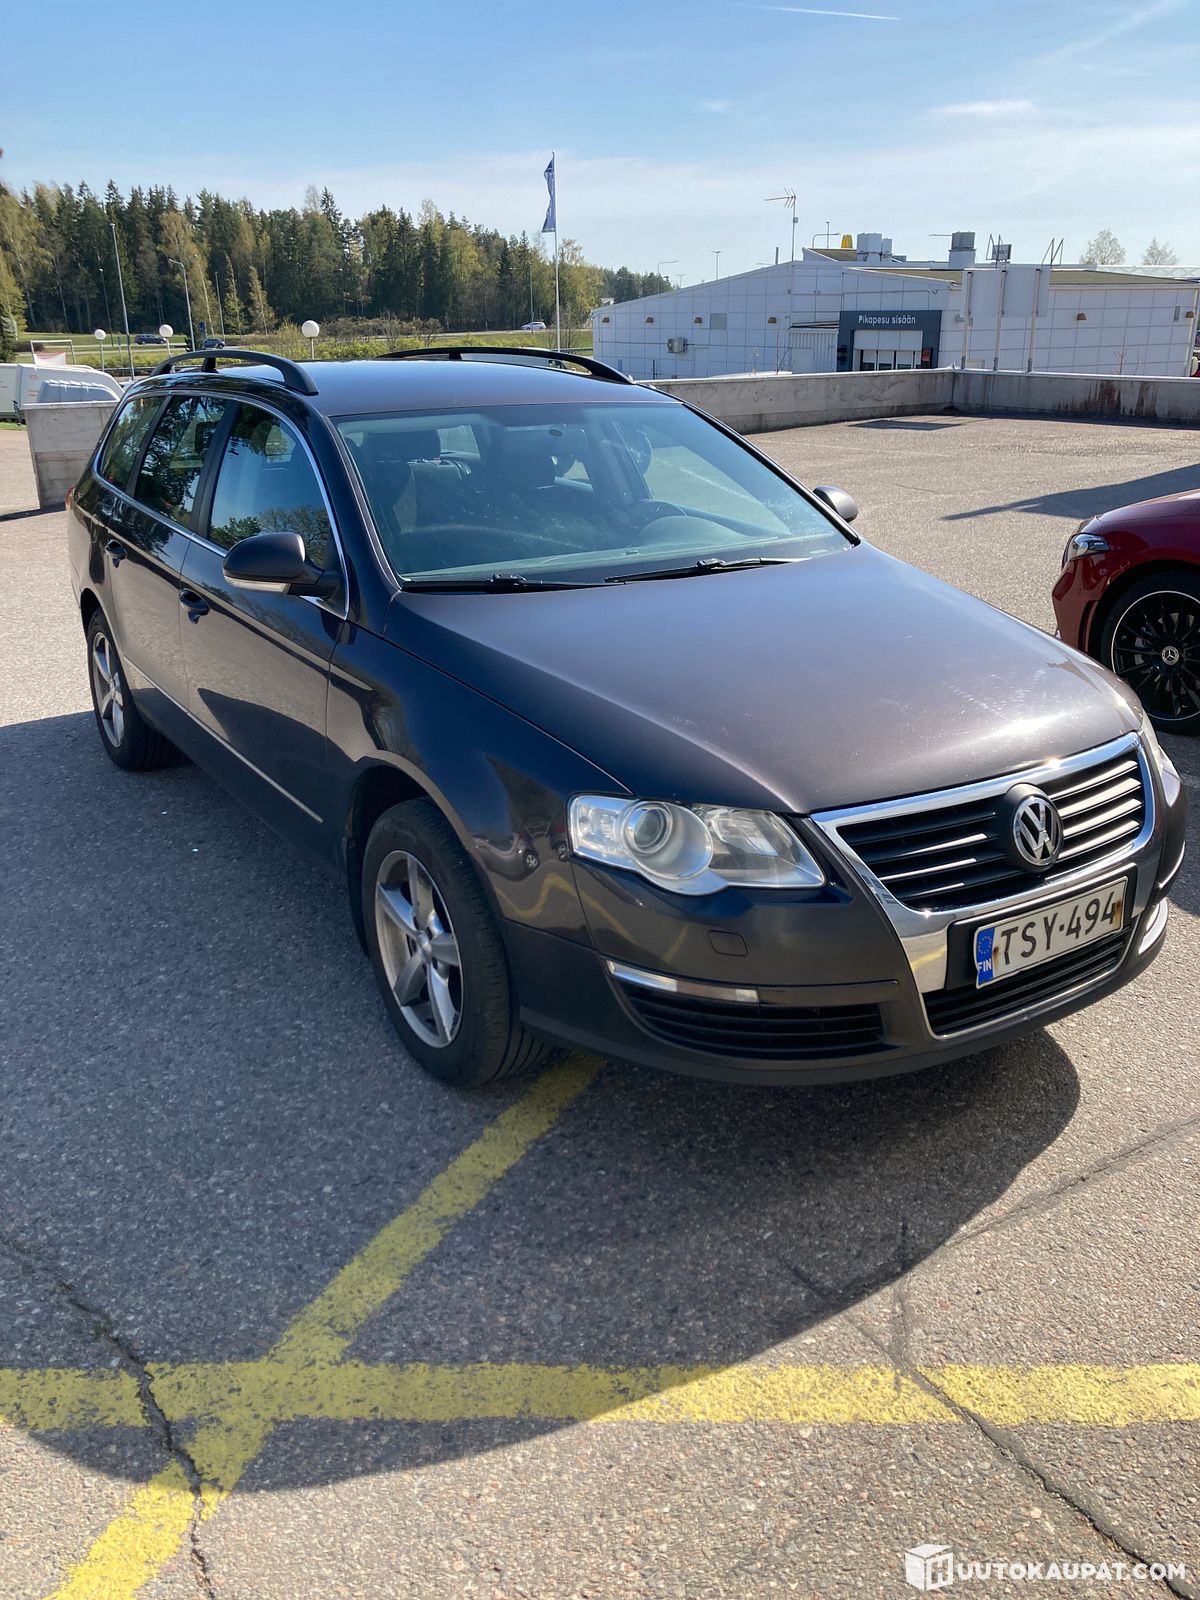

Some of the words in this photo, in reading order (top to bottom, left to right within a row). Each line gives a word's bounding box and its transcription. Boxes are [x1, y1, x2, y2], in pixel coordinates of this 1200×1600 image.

[858, 315, 890, 326] Pikapesu
[891, 315, 916, 324] sisään
[1000, 892, 1117, 965] TSY-494
[977, 958, 993, 972] FIN
